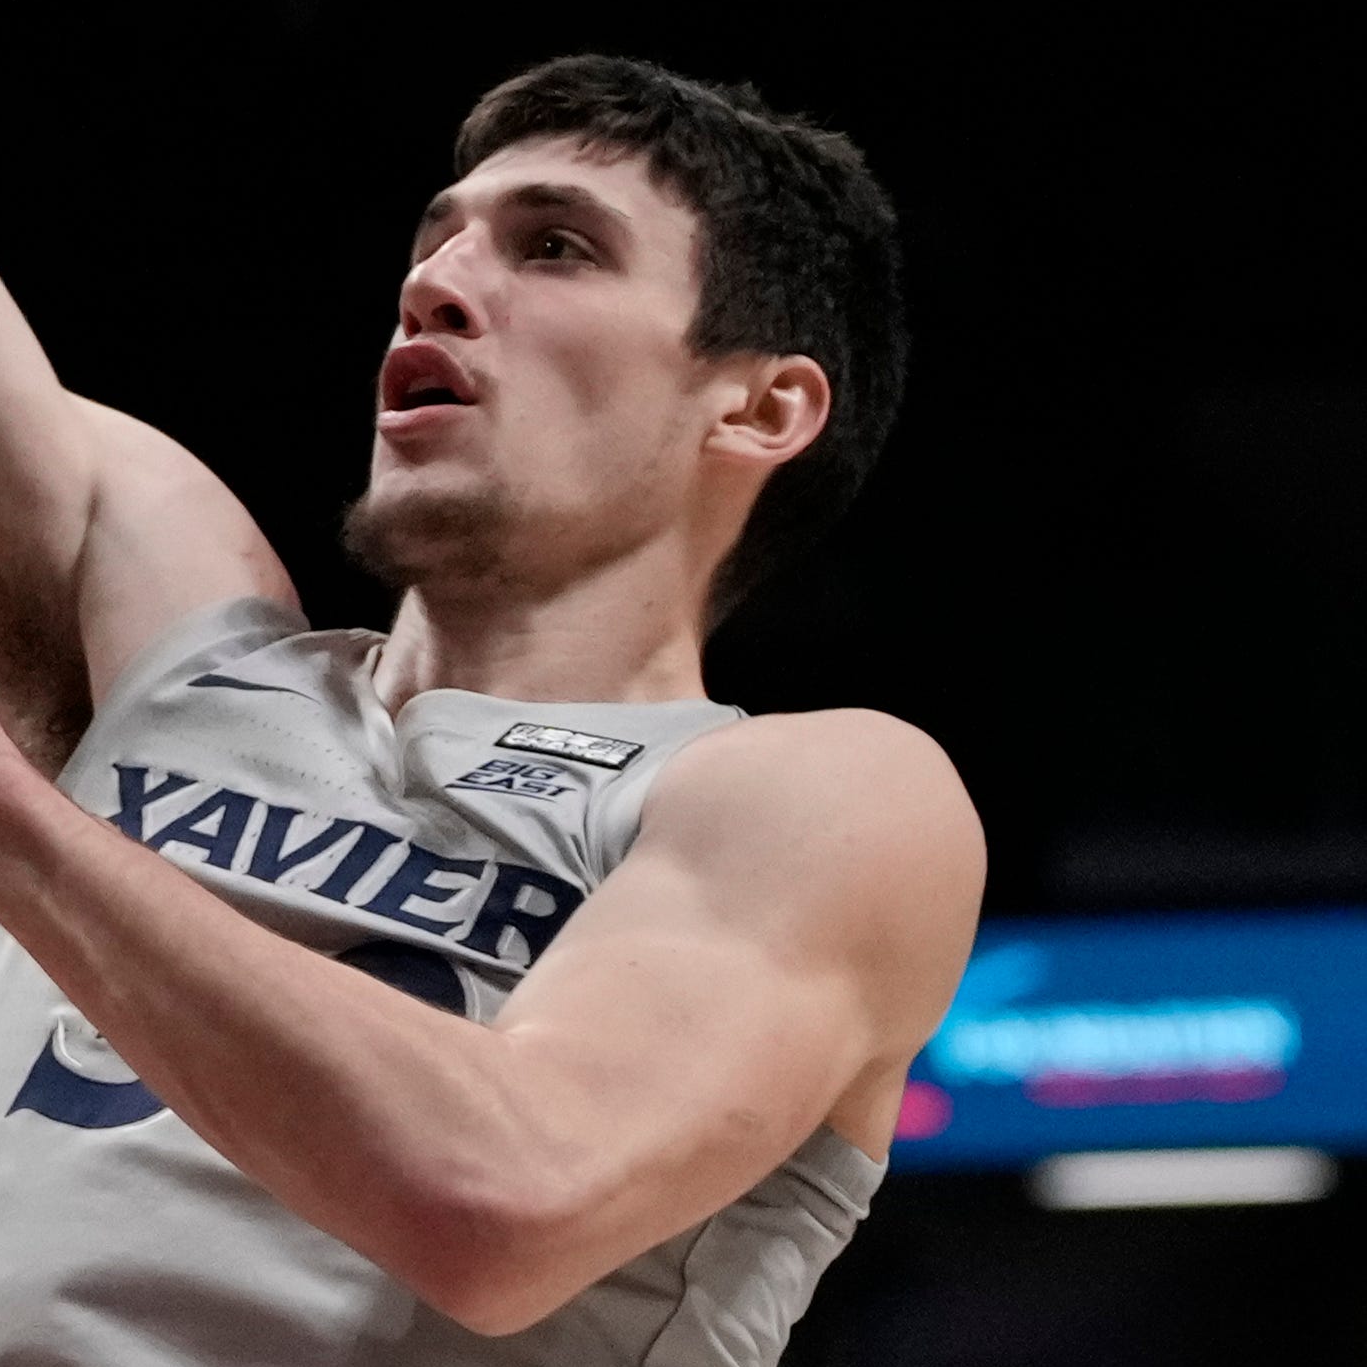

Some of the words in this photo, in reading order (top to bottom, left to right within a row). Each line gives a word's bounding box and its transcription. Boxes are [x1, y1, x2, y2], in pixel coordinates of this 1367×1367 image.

[477, 758, 568, 781] BIG
[455, 771, 577, 797] EAST
[111, 763, 586, 969] XAVIER
